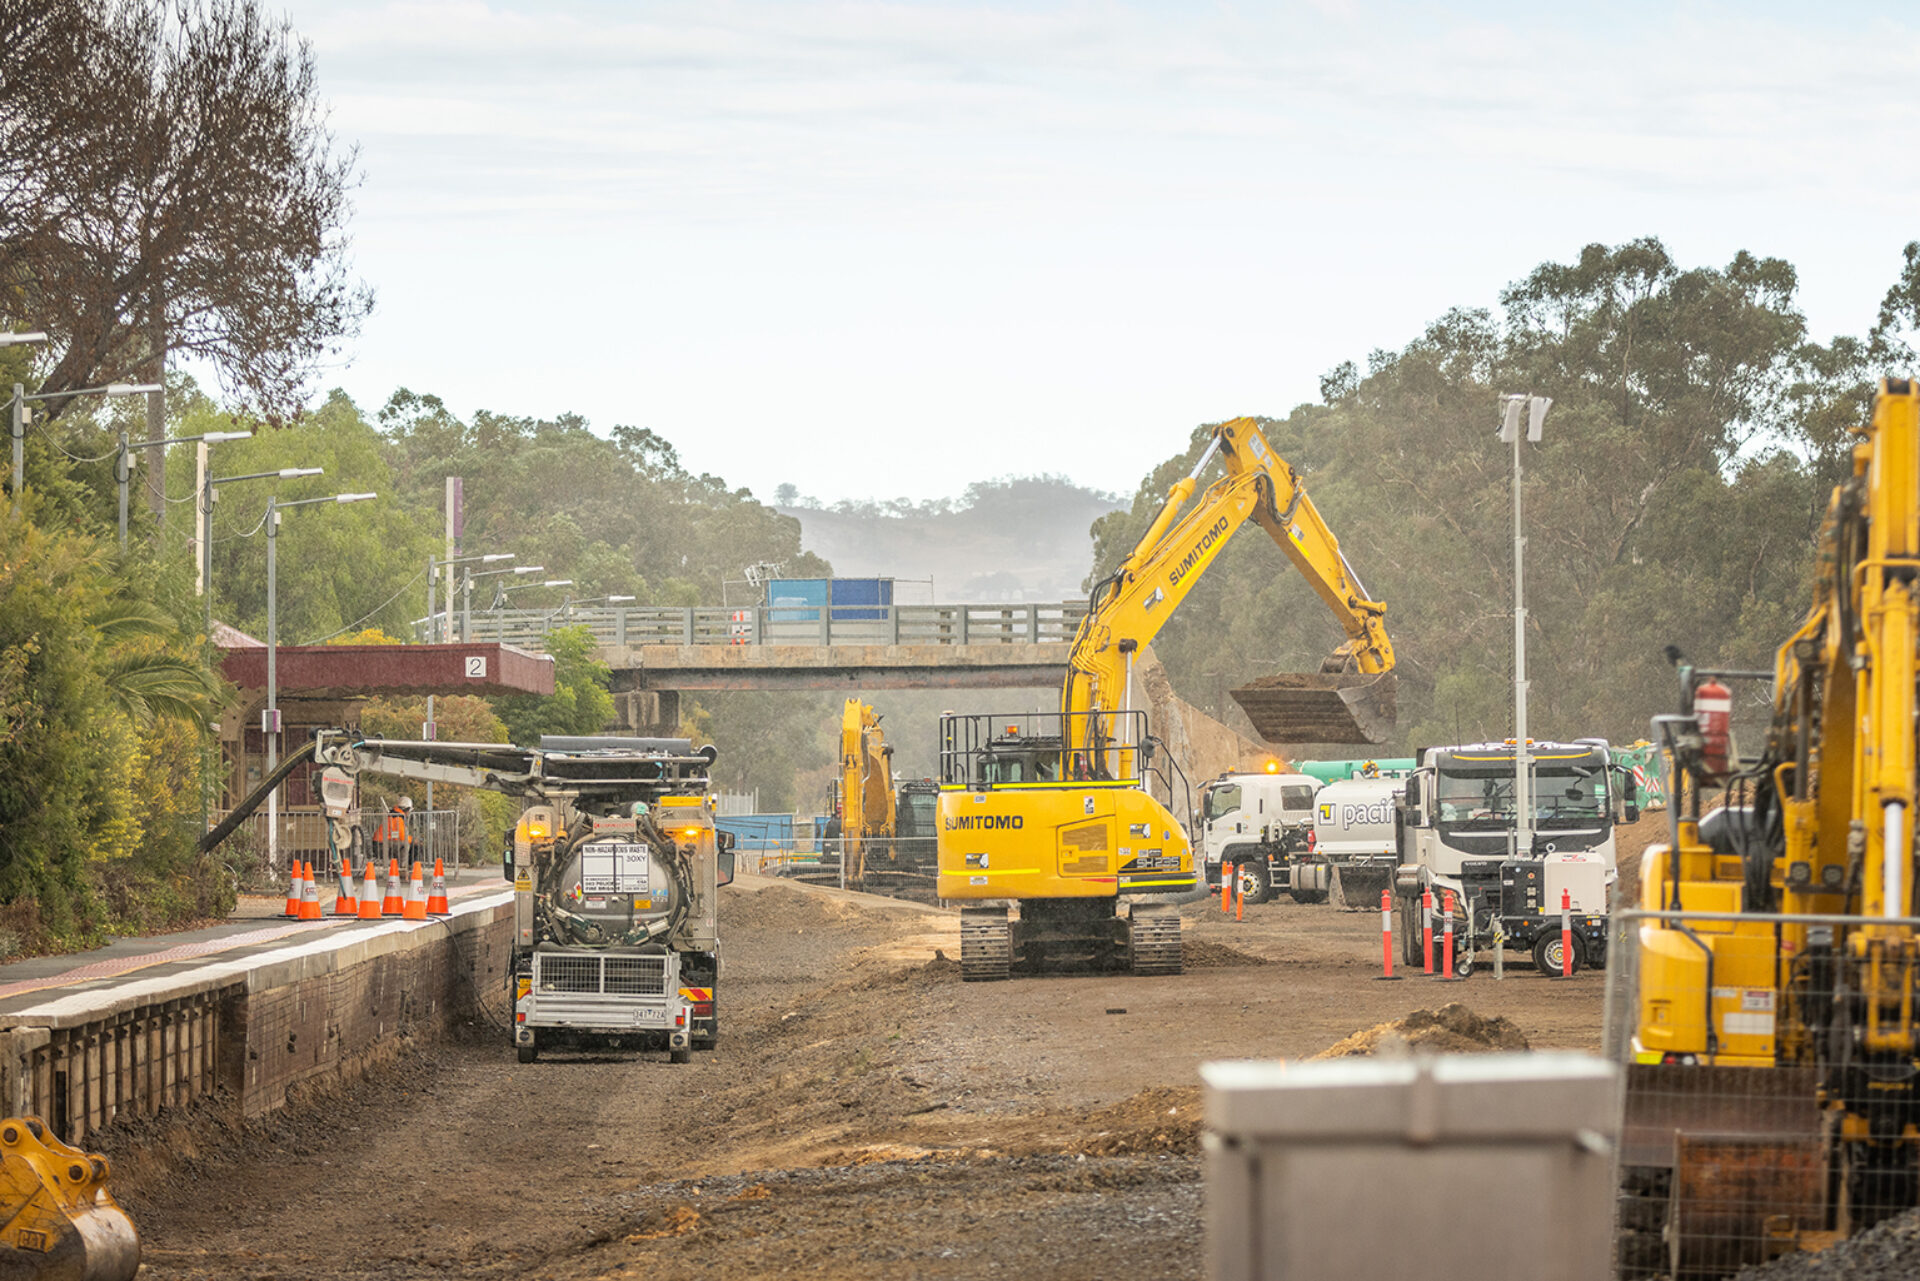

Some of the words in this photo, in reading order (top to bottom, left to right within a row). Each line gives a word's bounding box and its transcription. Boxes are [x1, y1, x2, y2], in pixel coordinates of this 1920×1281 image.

[1168, 515, 1229, 586] SUMITOMO
[470, 658, 481, 675] 2
[945, 815, 1024, 831] SUMITOMO
